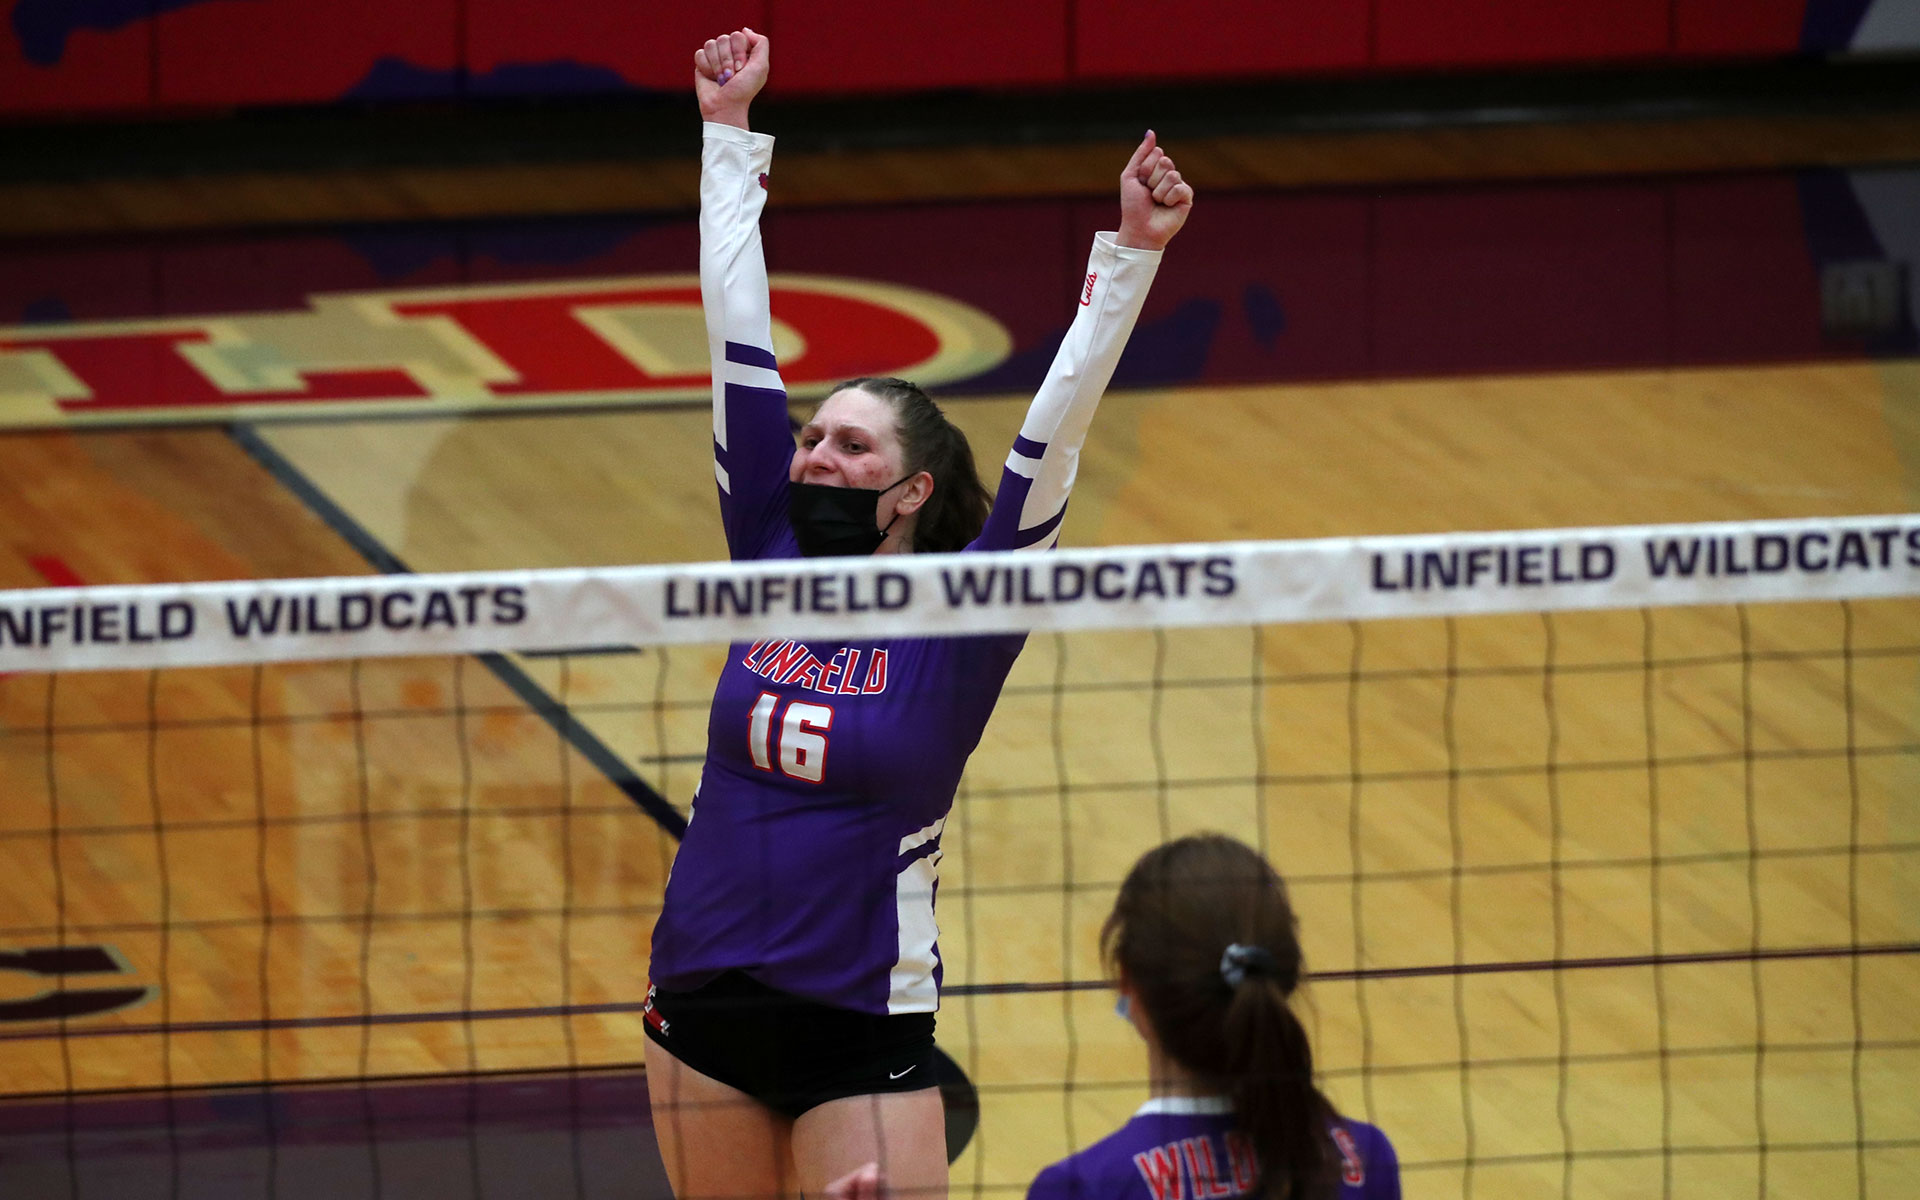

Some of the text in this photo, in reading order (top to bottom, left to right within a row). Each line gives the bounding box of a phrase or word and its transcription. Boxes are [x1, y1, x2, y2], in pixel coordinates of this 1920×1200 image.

[664, 558, 1236, 618] LINFIELD WILDCATS
[1371, 543, 1616, 591] LINFIELD
[226, 586, 527, 637] WILDCATS
[742, 638, 888, 696] LINFELD
[746, 690, 835, 784] 16
[1133, 1126, 1365, 1200] WILDS
